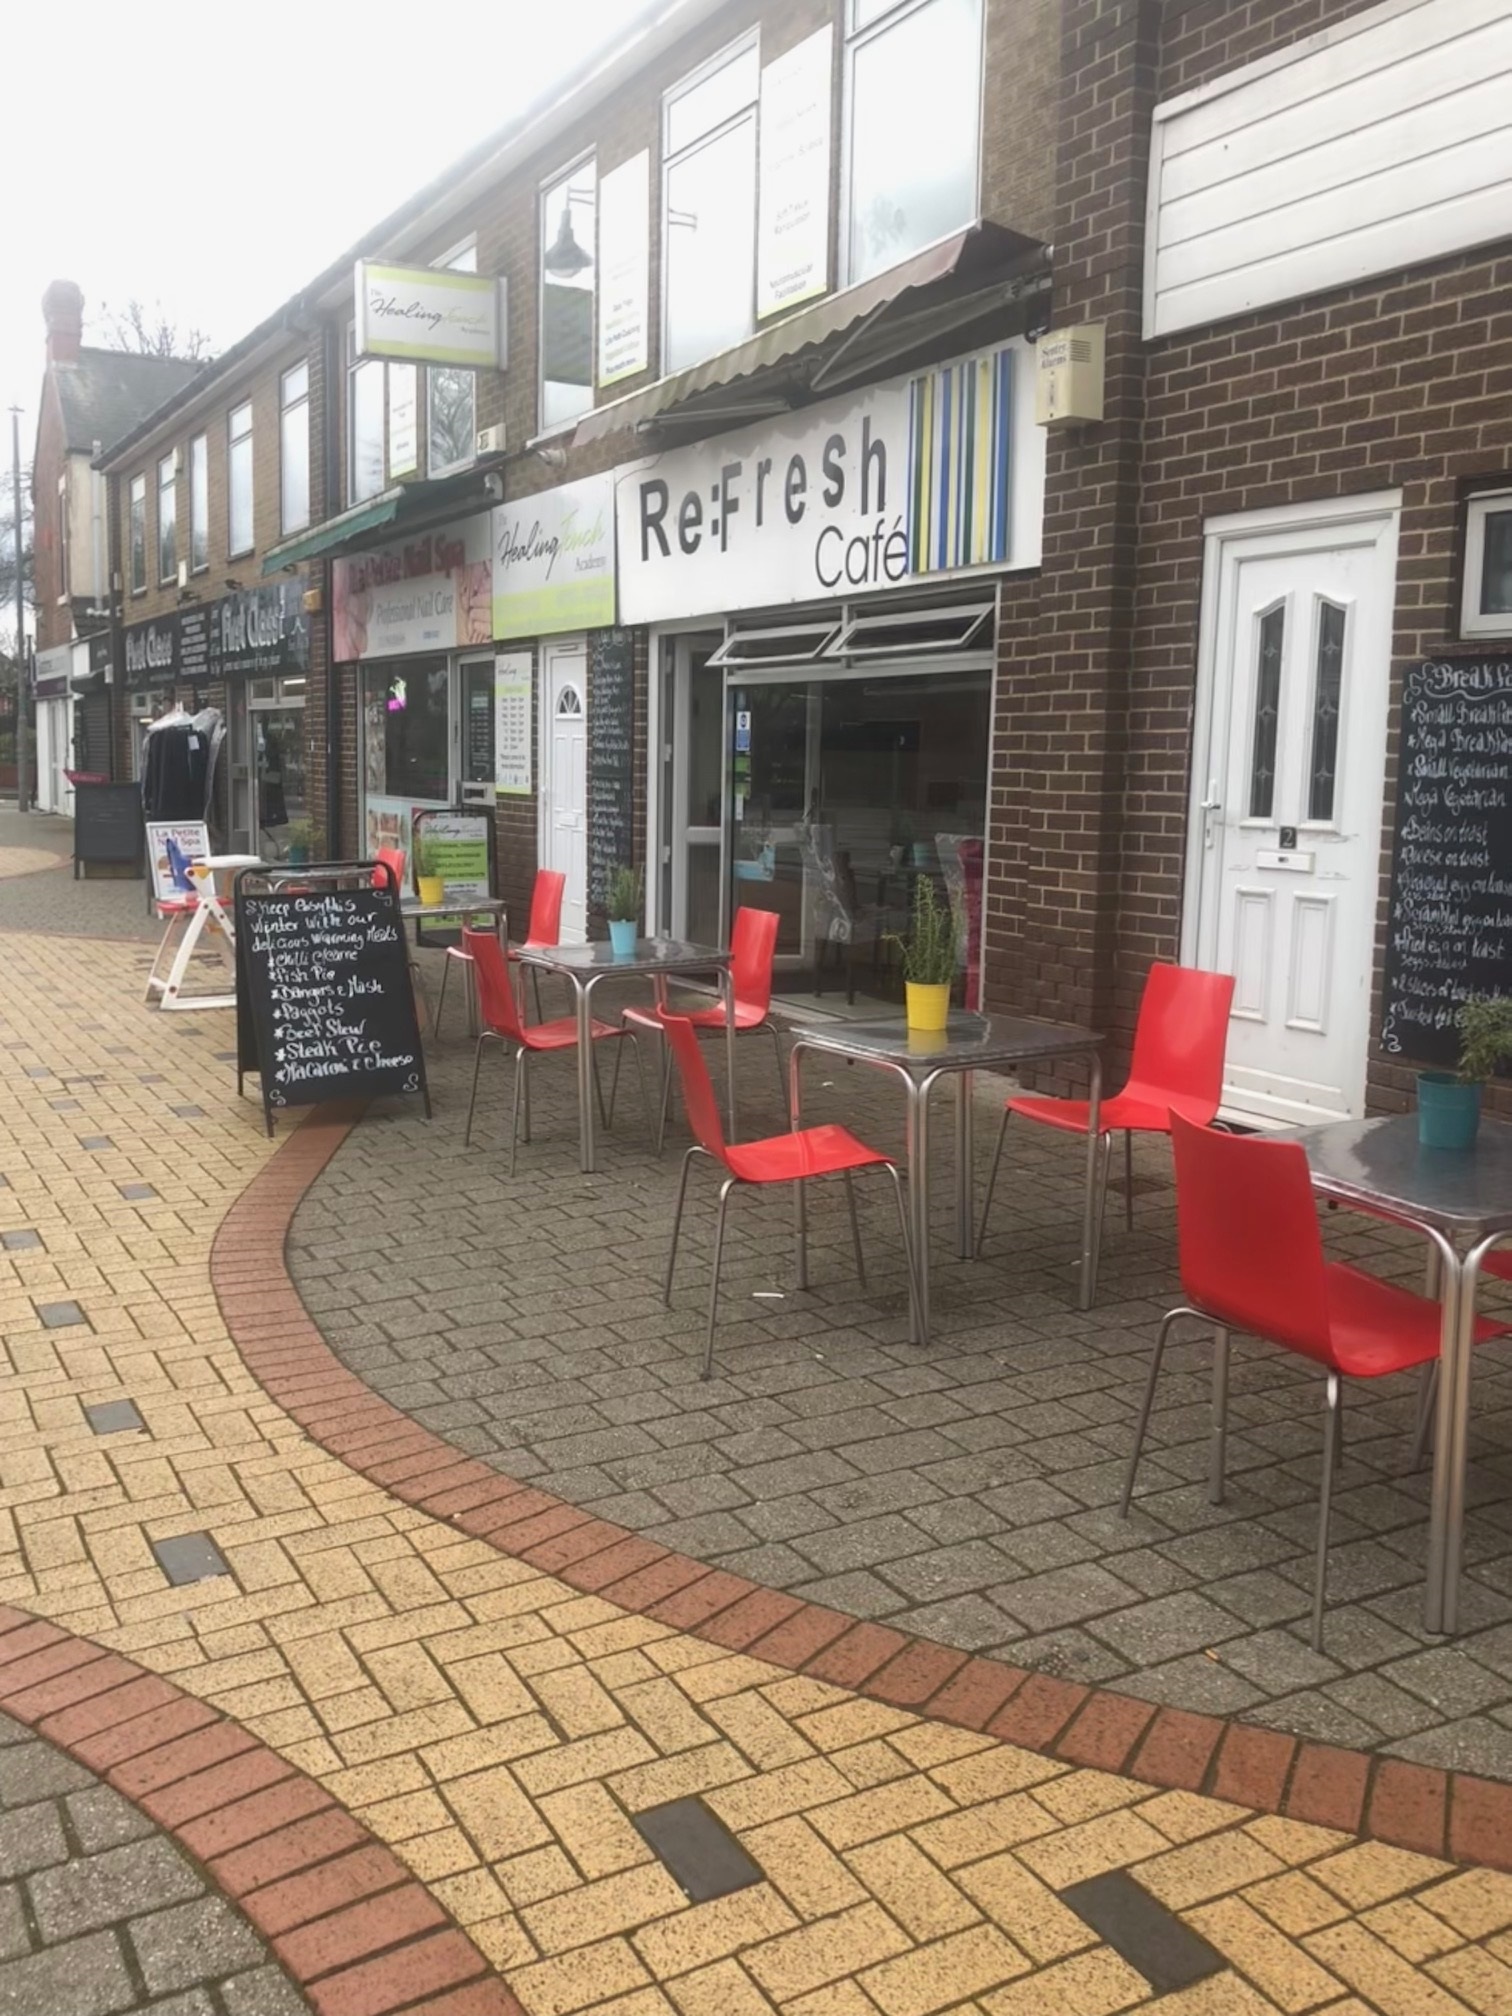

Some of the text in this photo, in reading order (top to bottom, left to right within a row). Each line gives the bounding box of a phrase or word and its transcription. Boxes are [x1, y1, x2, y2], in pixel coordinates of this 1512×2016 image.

[370, 297, 442, 331] Healing
[497, 520, 559, 581] Healing
[816, 514, 908, 589] Café
[1416, 700, 1456, 724] Small
[181, 838, 201, 847] Spa
[1282, 828, 1294, 847] 2
[311, 966, 336, 980] Pie
[348, 975, 385, 998] Mash
[326, 1018, 367, 1038] Stew
[286, 1036, 382, 1060] Steak Pie
